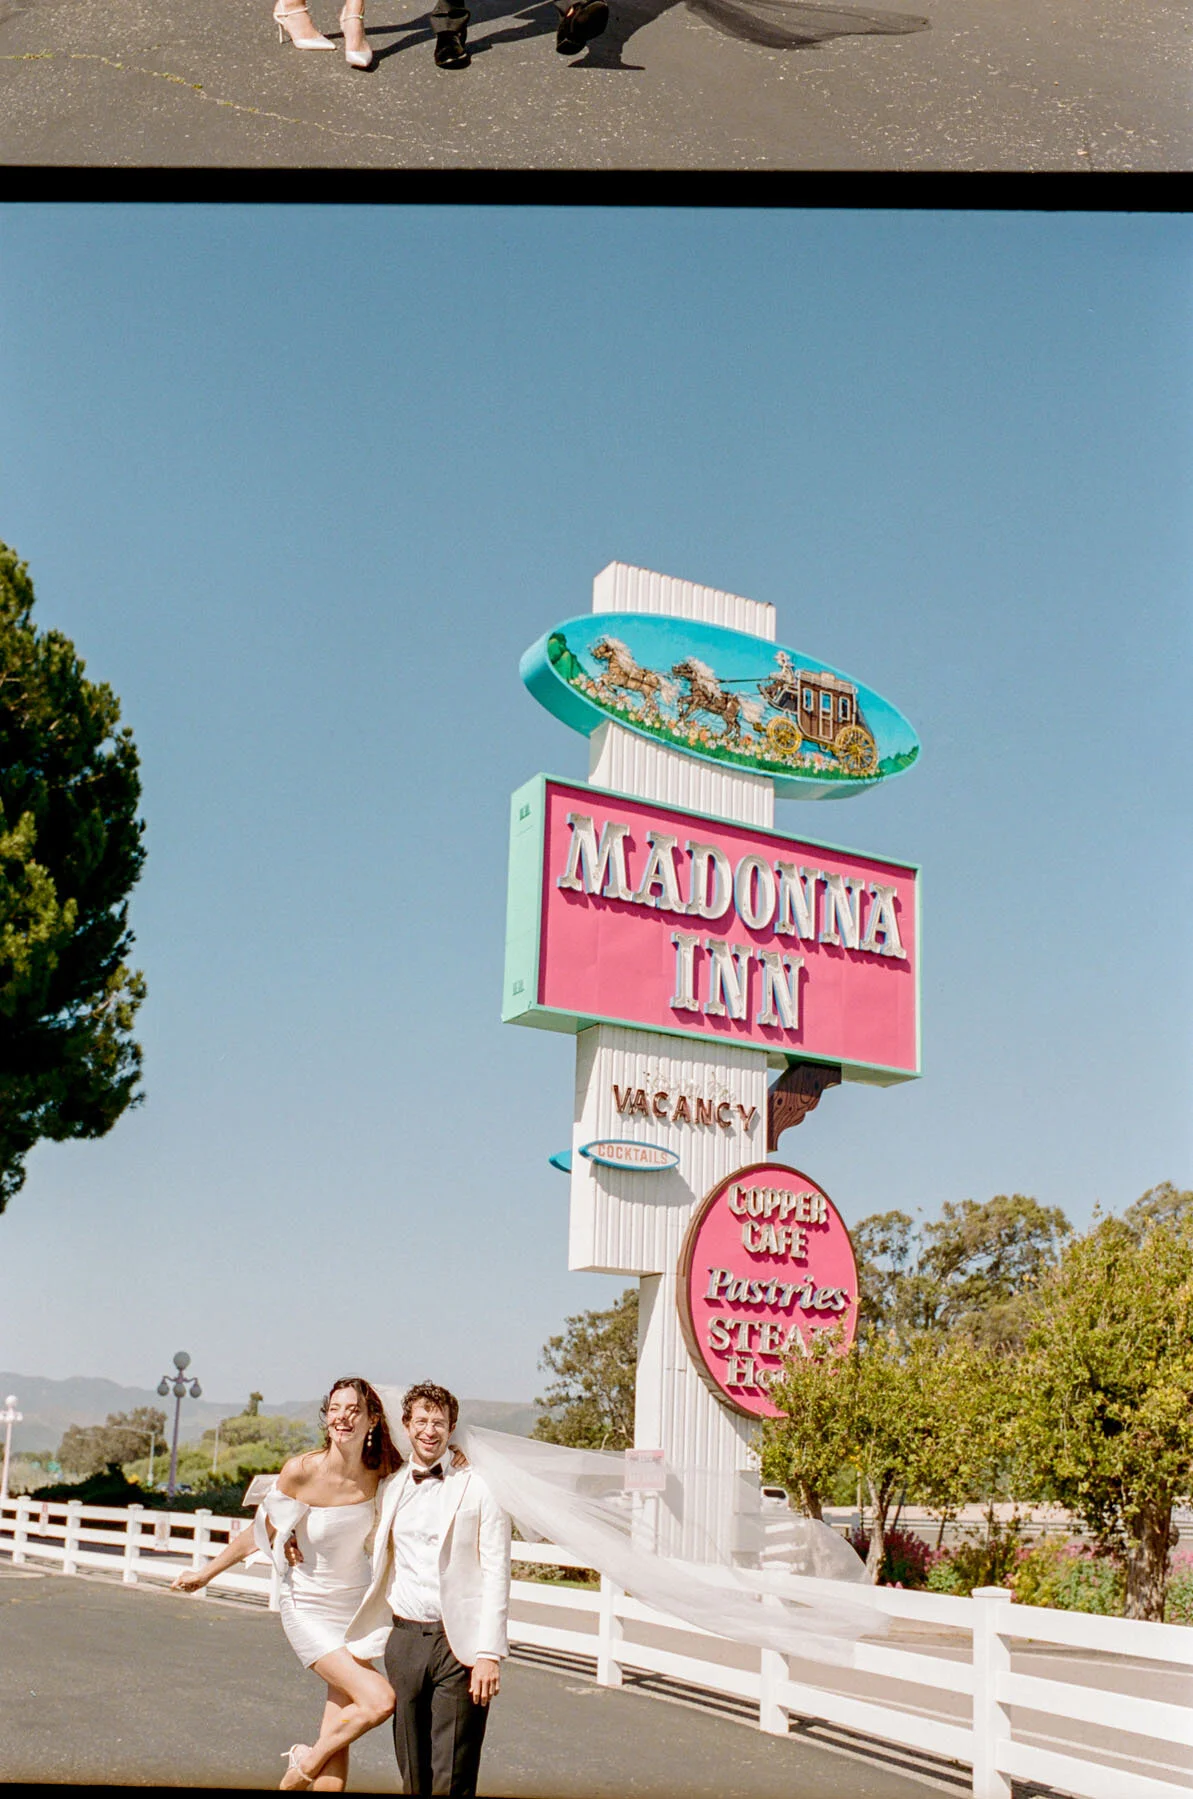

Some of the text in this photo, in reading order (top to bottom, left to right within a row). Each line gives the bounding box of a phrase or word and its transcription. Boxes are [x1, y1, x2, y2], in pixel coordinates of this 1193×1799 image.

[557, 813, 907, 959] MADONNA
[670, 932, 804, 1030] INN
[613, 1084, 756, 1131] VACANCY
[597, 1143, 668, 1165] COCKTAILS
[728, 1182, 828, 1225] COPPER
[742, 1220, 806, 1259] CAFE
[703, 1266, 848, 1311] Pastries
